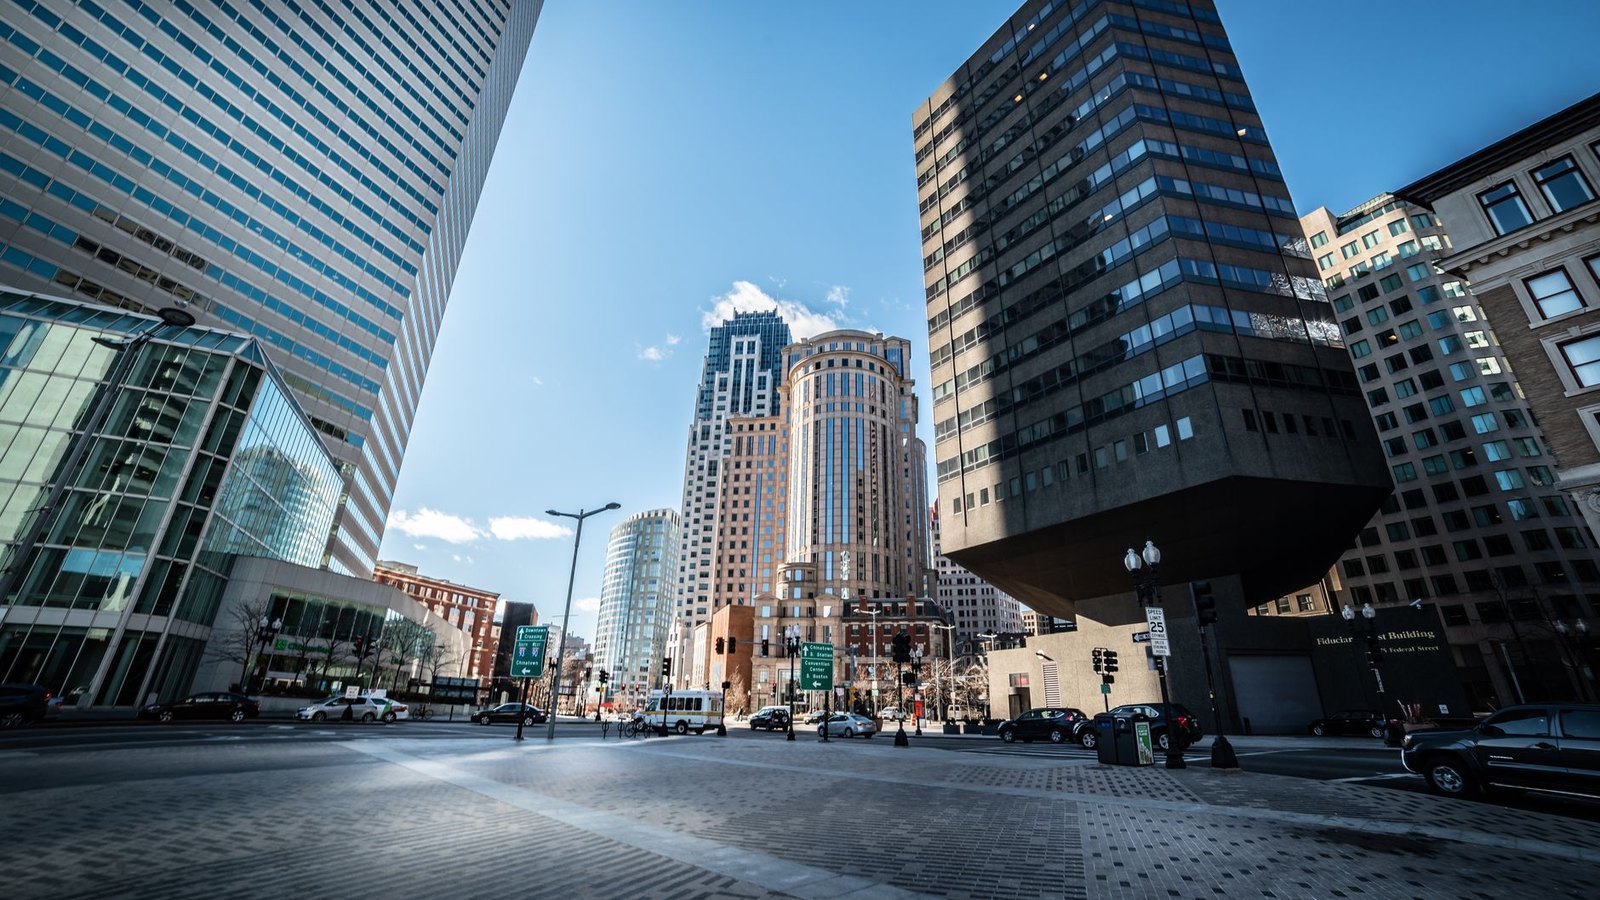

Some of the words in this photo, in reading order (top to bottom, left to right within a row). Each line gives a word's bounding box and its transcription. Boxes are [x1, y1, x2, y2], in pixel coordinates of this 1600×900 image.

[1150, 621, 1164, 633] 25
[1316, 636, 1354, 646] Fiduciar
[1388, 630, 1435, 640] Building
[1388, 645, 1415, 653] Federal
[1417, 644, 1440, 652] Street
